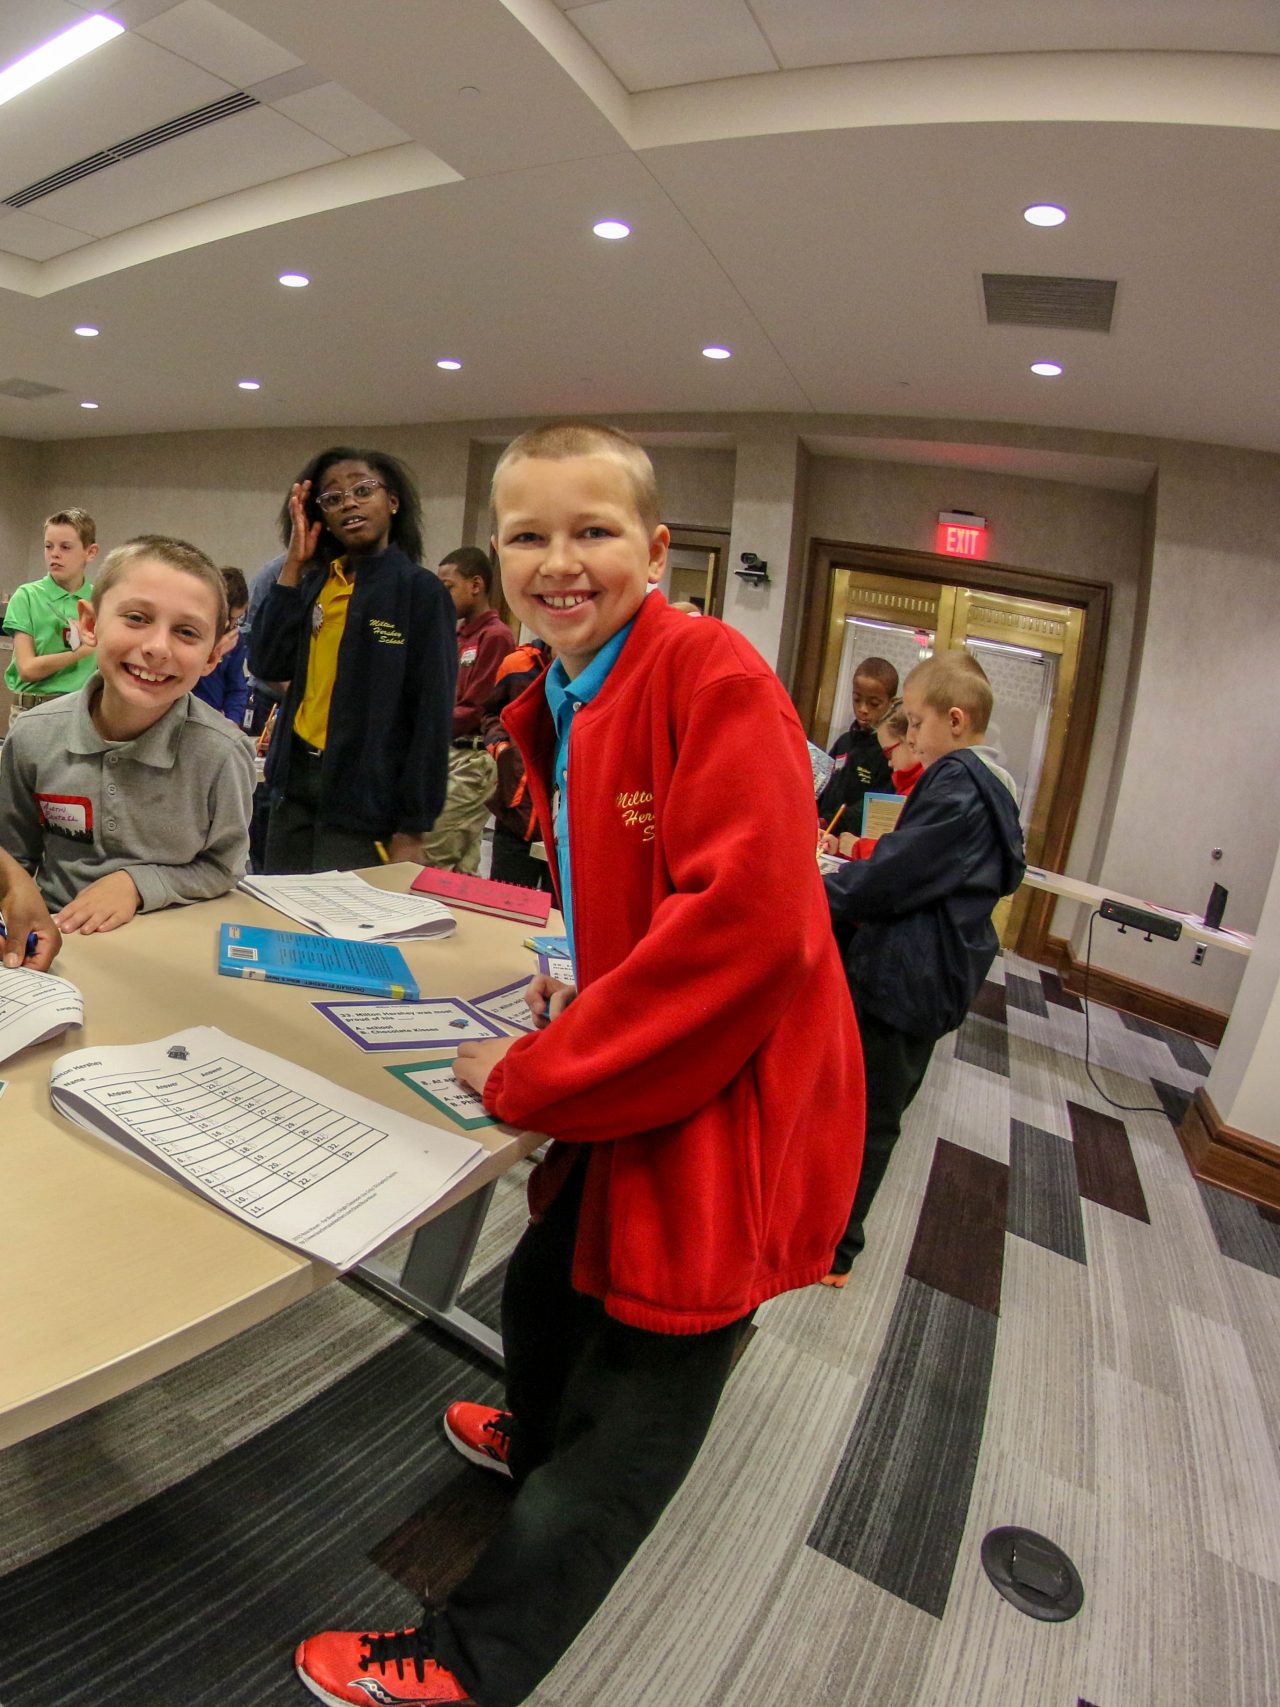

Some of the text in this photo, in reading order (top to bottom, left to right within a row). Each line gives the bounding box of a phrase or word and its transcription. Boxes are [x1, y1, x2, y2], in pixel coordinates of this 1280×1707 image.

[946, 527, 979, 555] EXIT
[615, 790, 653, 808] Milto
[622, 809, 655, 827] Her
[201, 1066, 223, 1078] Answer
[155, 1081, 178, 1090] Answer
[107, 1088, 133, 1099] Answer
